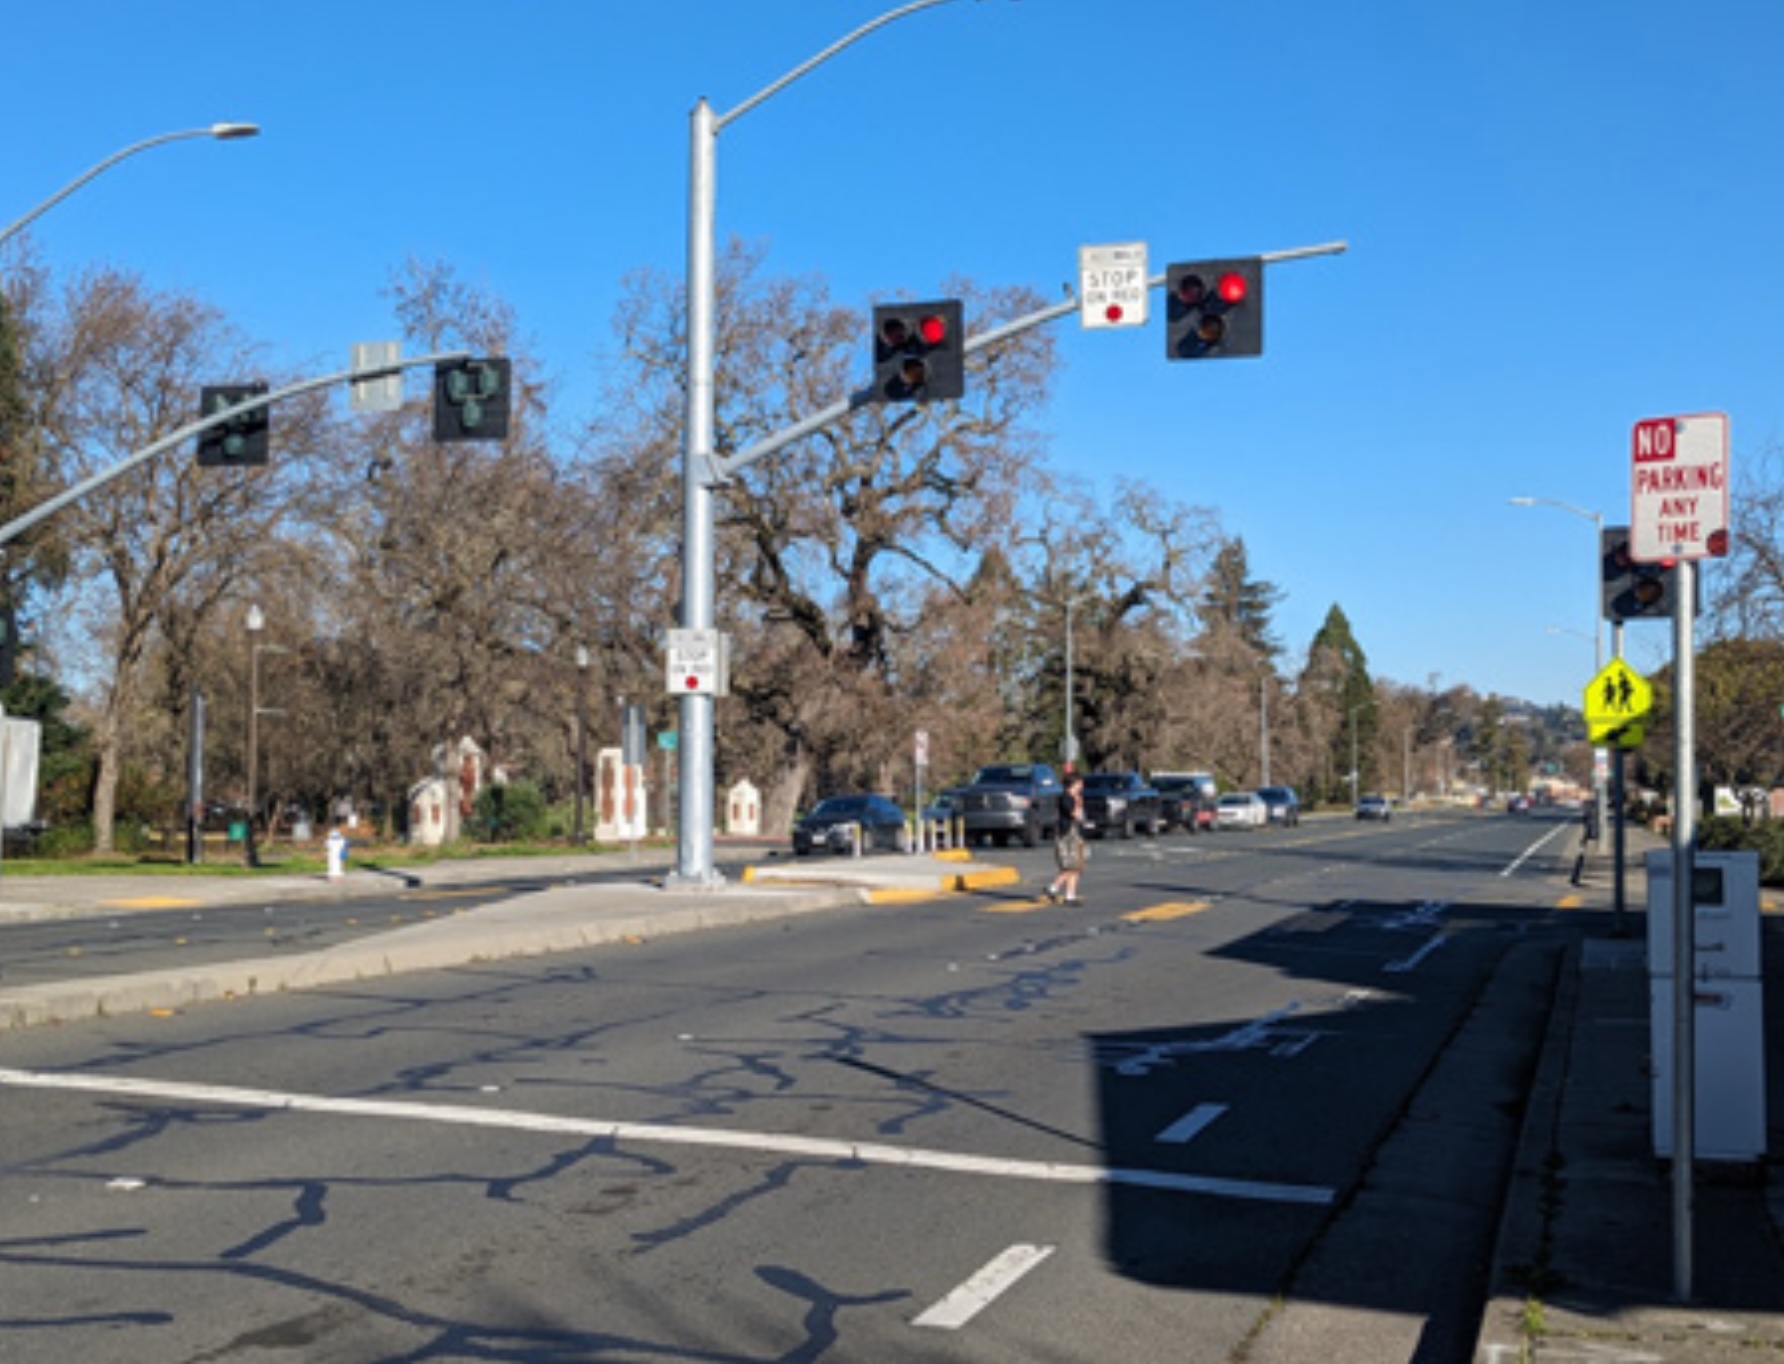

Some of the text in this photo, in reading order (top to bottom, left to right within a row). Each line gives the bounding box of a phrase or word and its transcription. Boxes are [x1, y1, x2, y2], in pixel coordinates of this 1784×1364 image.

[1088, 270, 1139, 288] STOP
[1637, 423, 1671, 456] NO
[1636, 463, 1723, 494] PARKING
[1660, 498, 1699, 517] ANY
[1658, 522, 1701, 543] TIME
